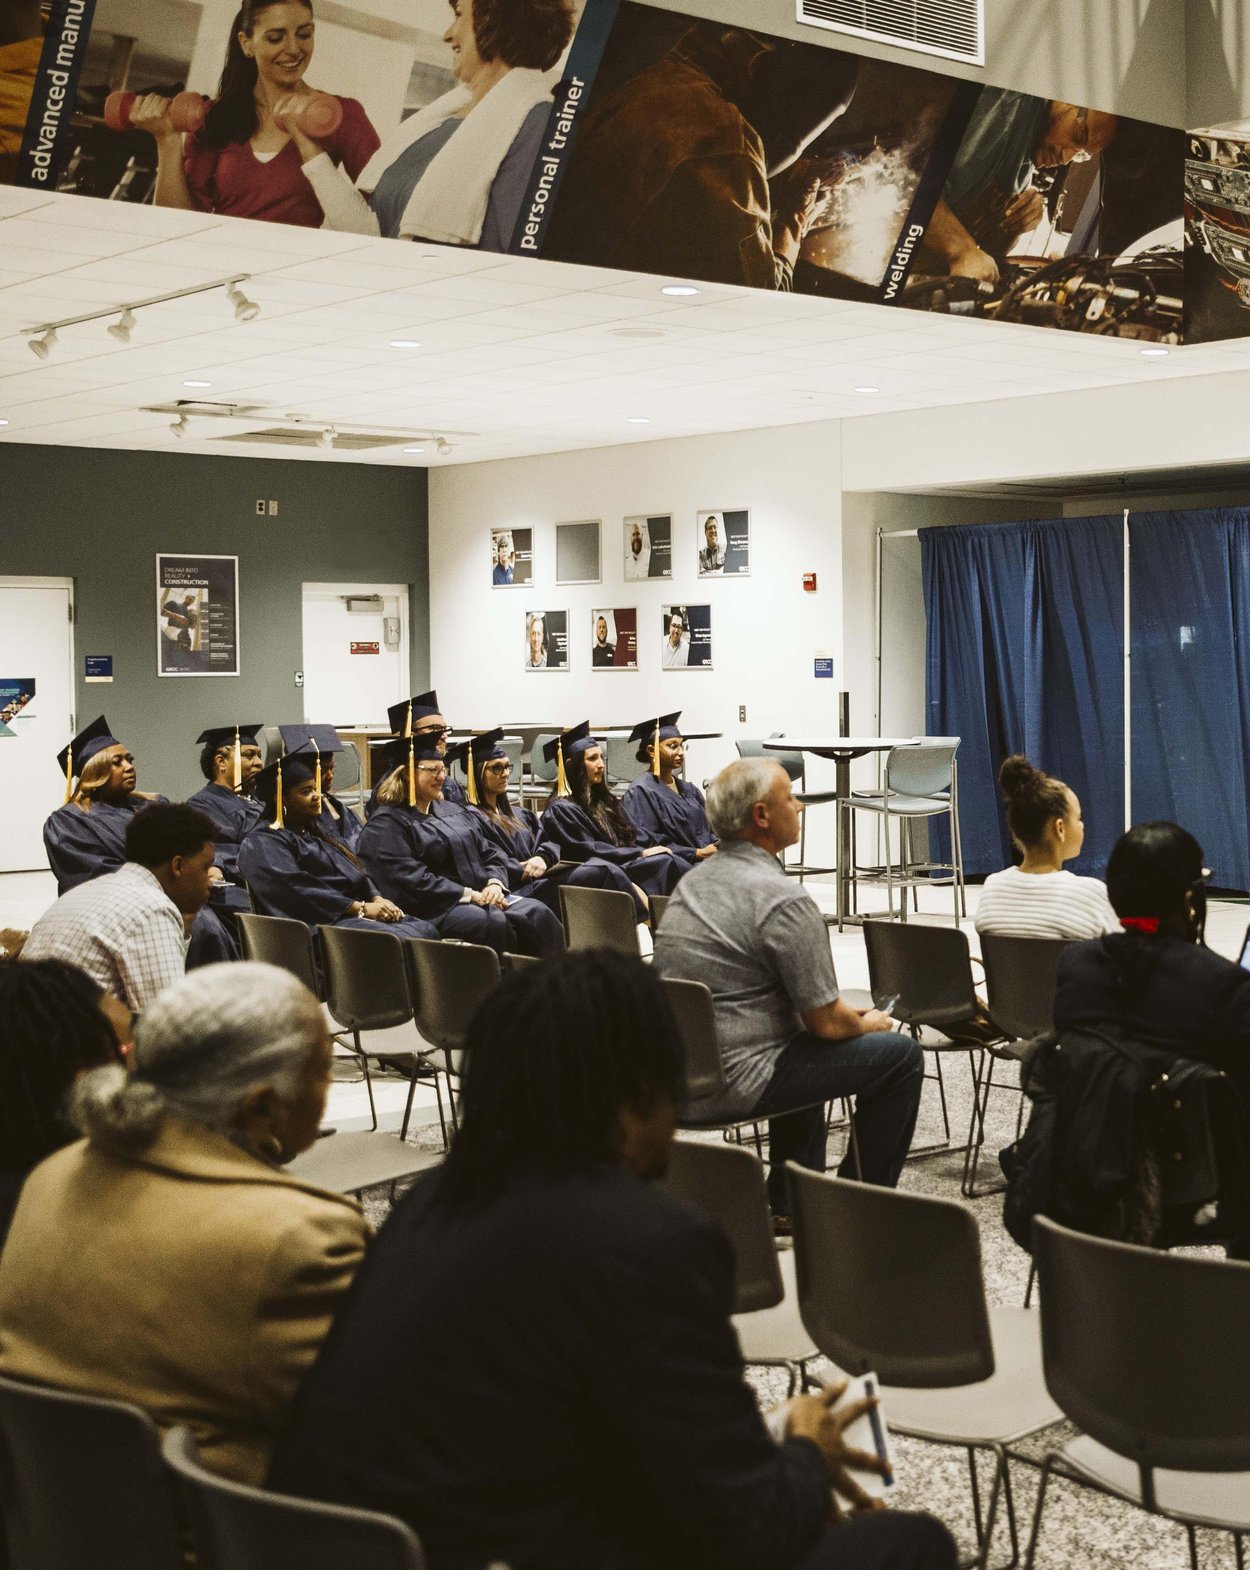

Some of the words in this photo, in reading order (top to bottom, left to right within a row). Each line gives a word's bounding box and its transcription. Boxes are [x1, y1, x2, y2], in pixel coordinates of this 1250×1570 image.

[29, 69, 70, 182] advanced
[520, 156, 561, 250] personal
[549, 76, 585, 150] trainer
[883, 224, 924, 299] welding
